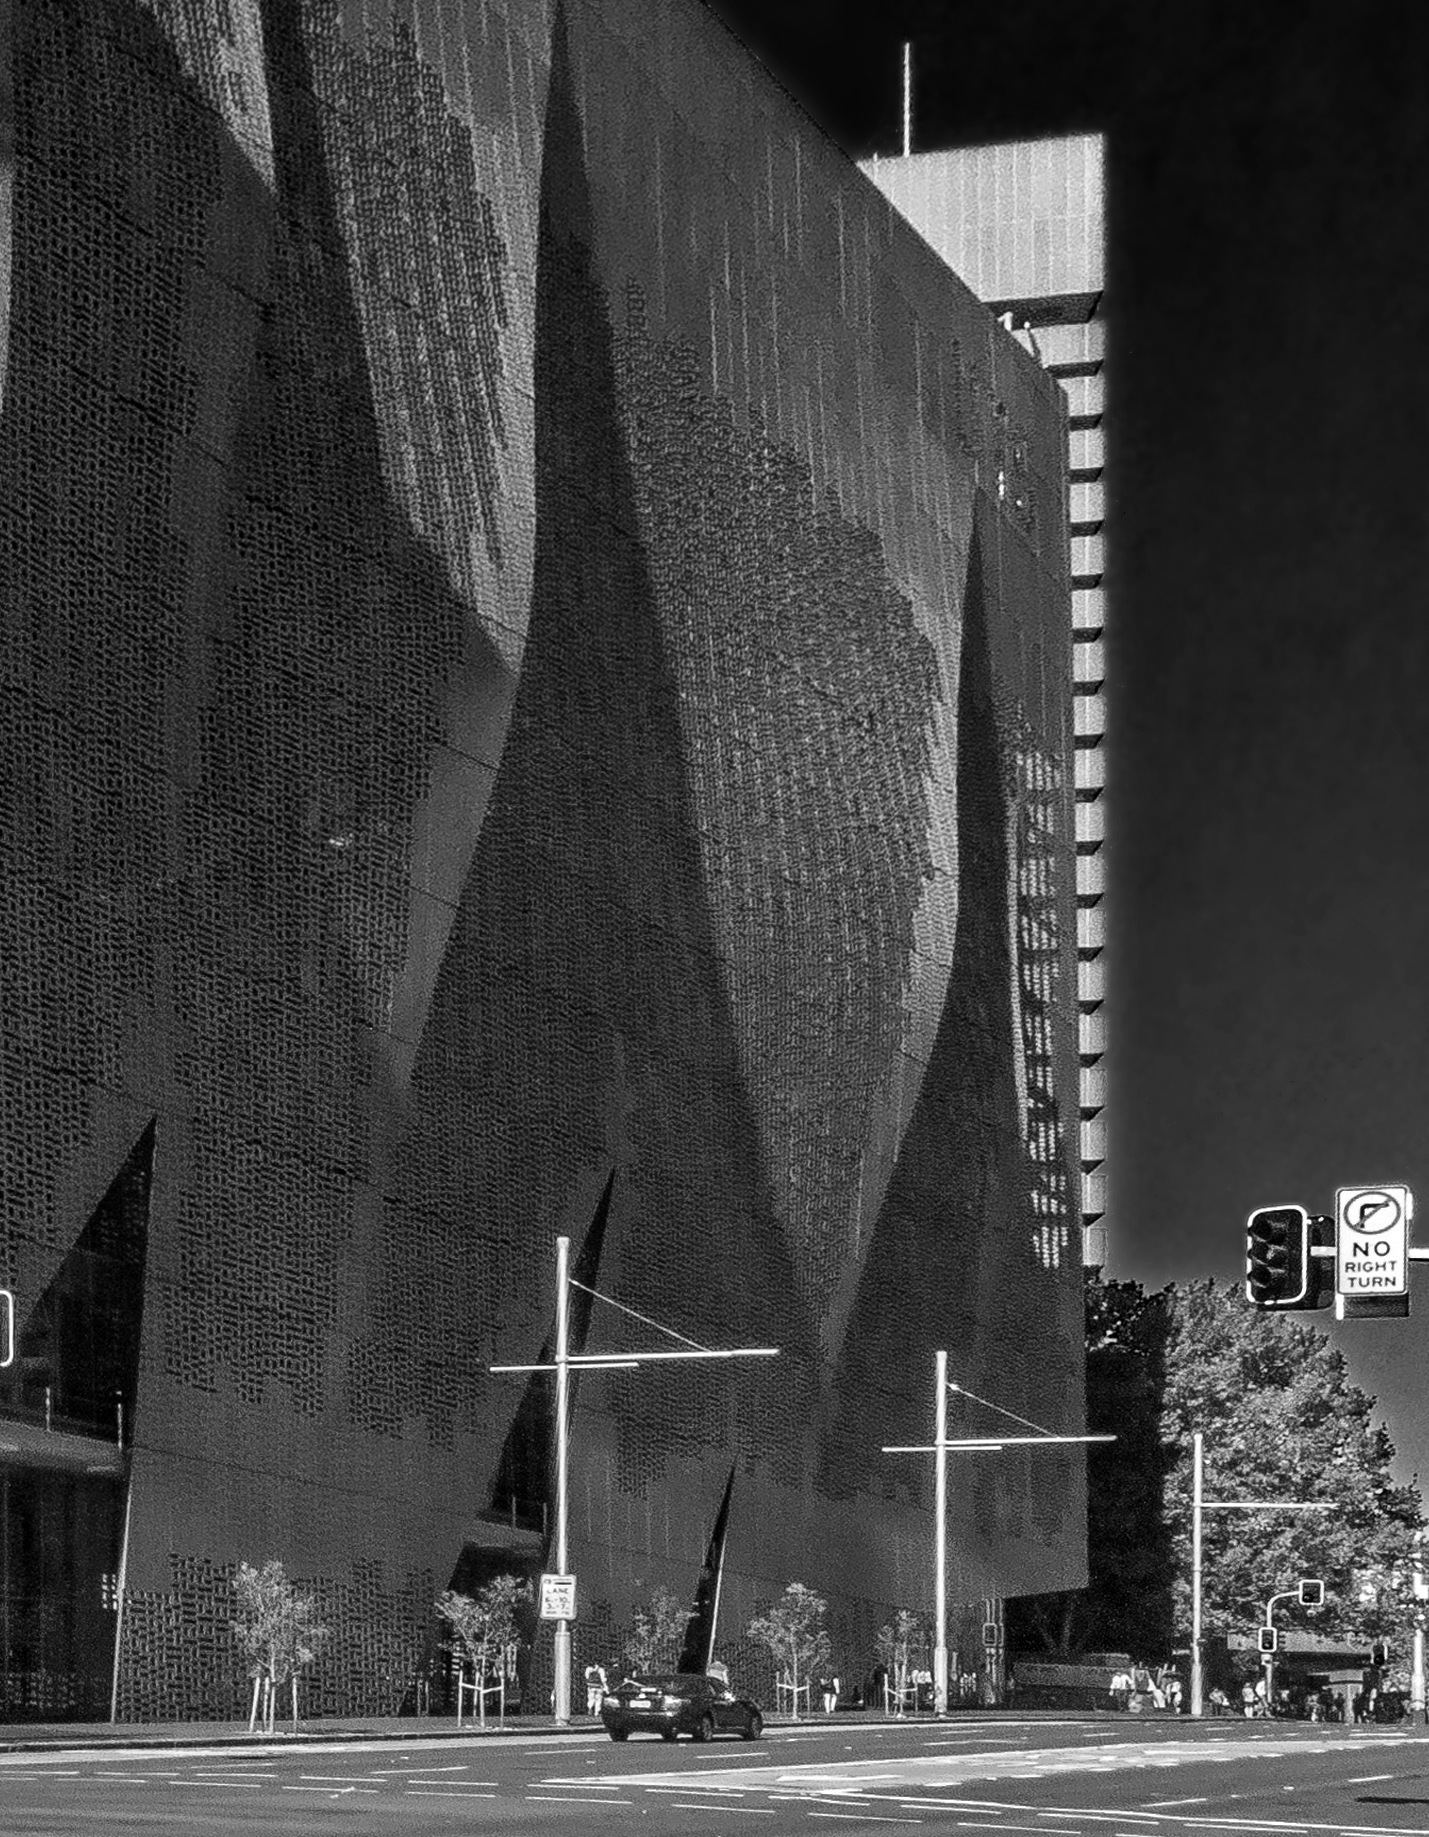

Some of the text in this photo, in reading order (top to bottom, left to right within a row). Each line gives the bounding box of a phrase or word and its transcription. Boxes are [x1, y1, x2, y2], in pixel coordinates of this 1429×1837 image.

[1352, 1240, 1391, 1258] NO
[1344, 1260, 1398, 1274] RIGHT
[1347, 1276, 1397, 1288] TURN
